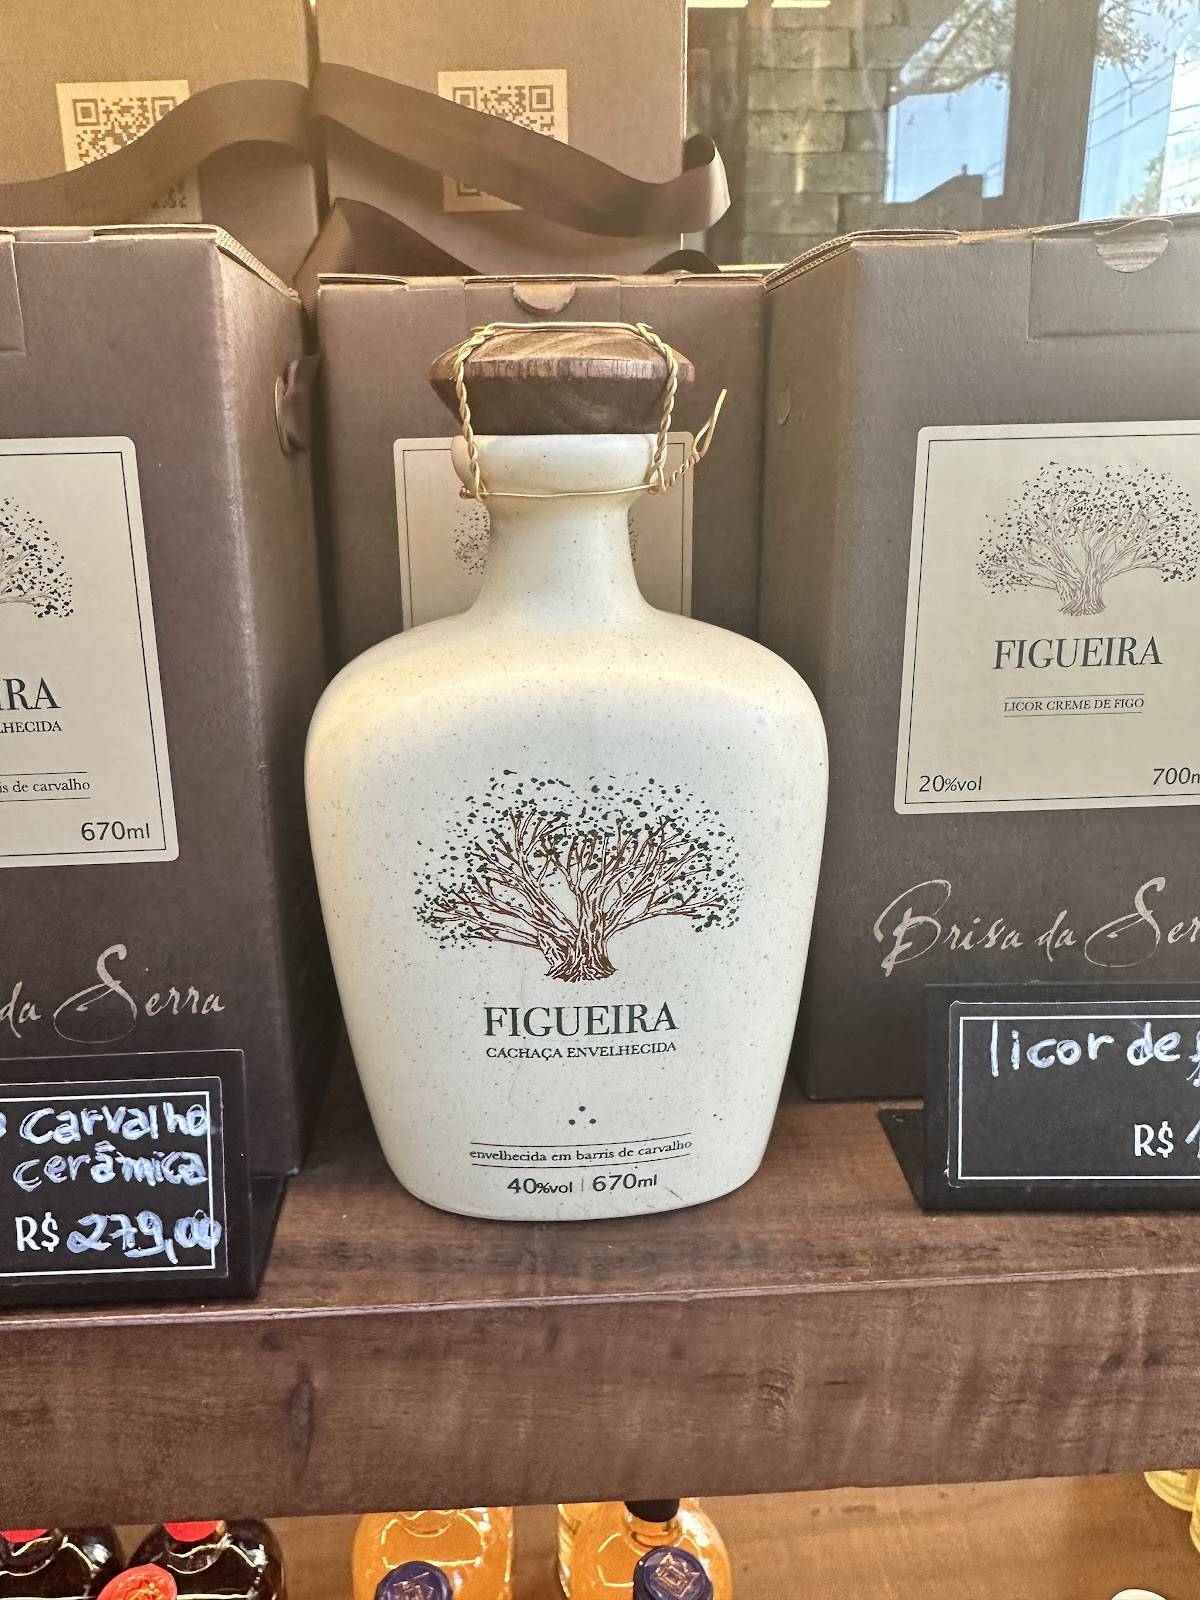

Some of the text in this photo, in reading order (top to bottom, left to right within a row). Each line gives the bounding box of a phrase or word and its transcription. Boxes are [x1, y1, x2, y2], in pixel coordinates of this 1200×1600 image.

[993, 636, 1163, 670] FIGUEIRA
[0, 677, 62, 711] RA
[1003, 698, 1145, 713] LICOR CREME DE FIGO
[12, 780, 29, 793] de
[32, 778, 91, 793] carvalho
[918, 775, 982, 793] 20%vol
[81, 821, 151, 842] 670ml
[873, 879, 1023, 978] Brisa
[1034, 909, 1077, 963] da
[53, 943, 226, 1044] Serra
[483, 1001, 680, 1037] FIGUEIRA
[486, 1041, 677, 1061] CACHAÇA ENVELHECIDA
[990, 1020, 1114, 1078] licor
[1126, 1021, 1181, 1067] de
[469, 1139, 693, 1162] envelhecida em barris de carvalho
[1134, 1120, 1174, 1159] R$
[12, 1141, 208, 1192] cerâmica
[507, 1173, 658, 1194] 40%vol 670ml
[15, 1212, 60, 1254] R$
